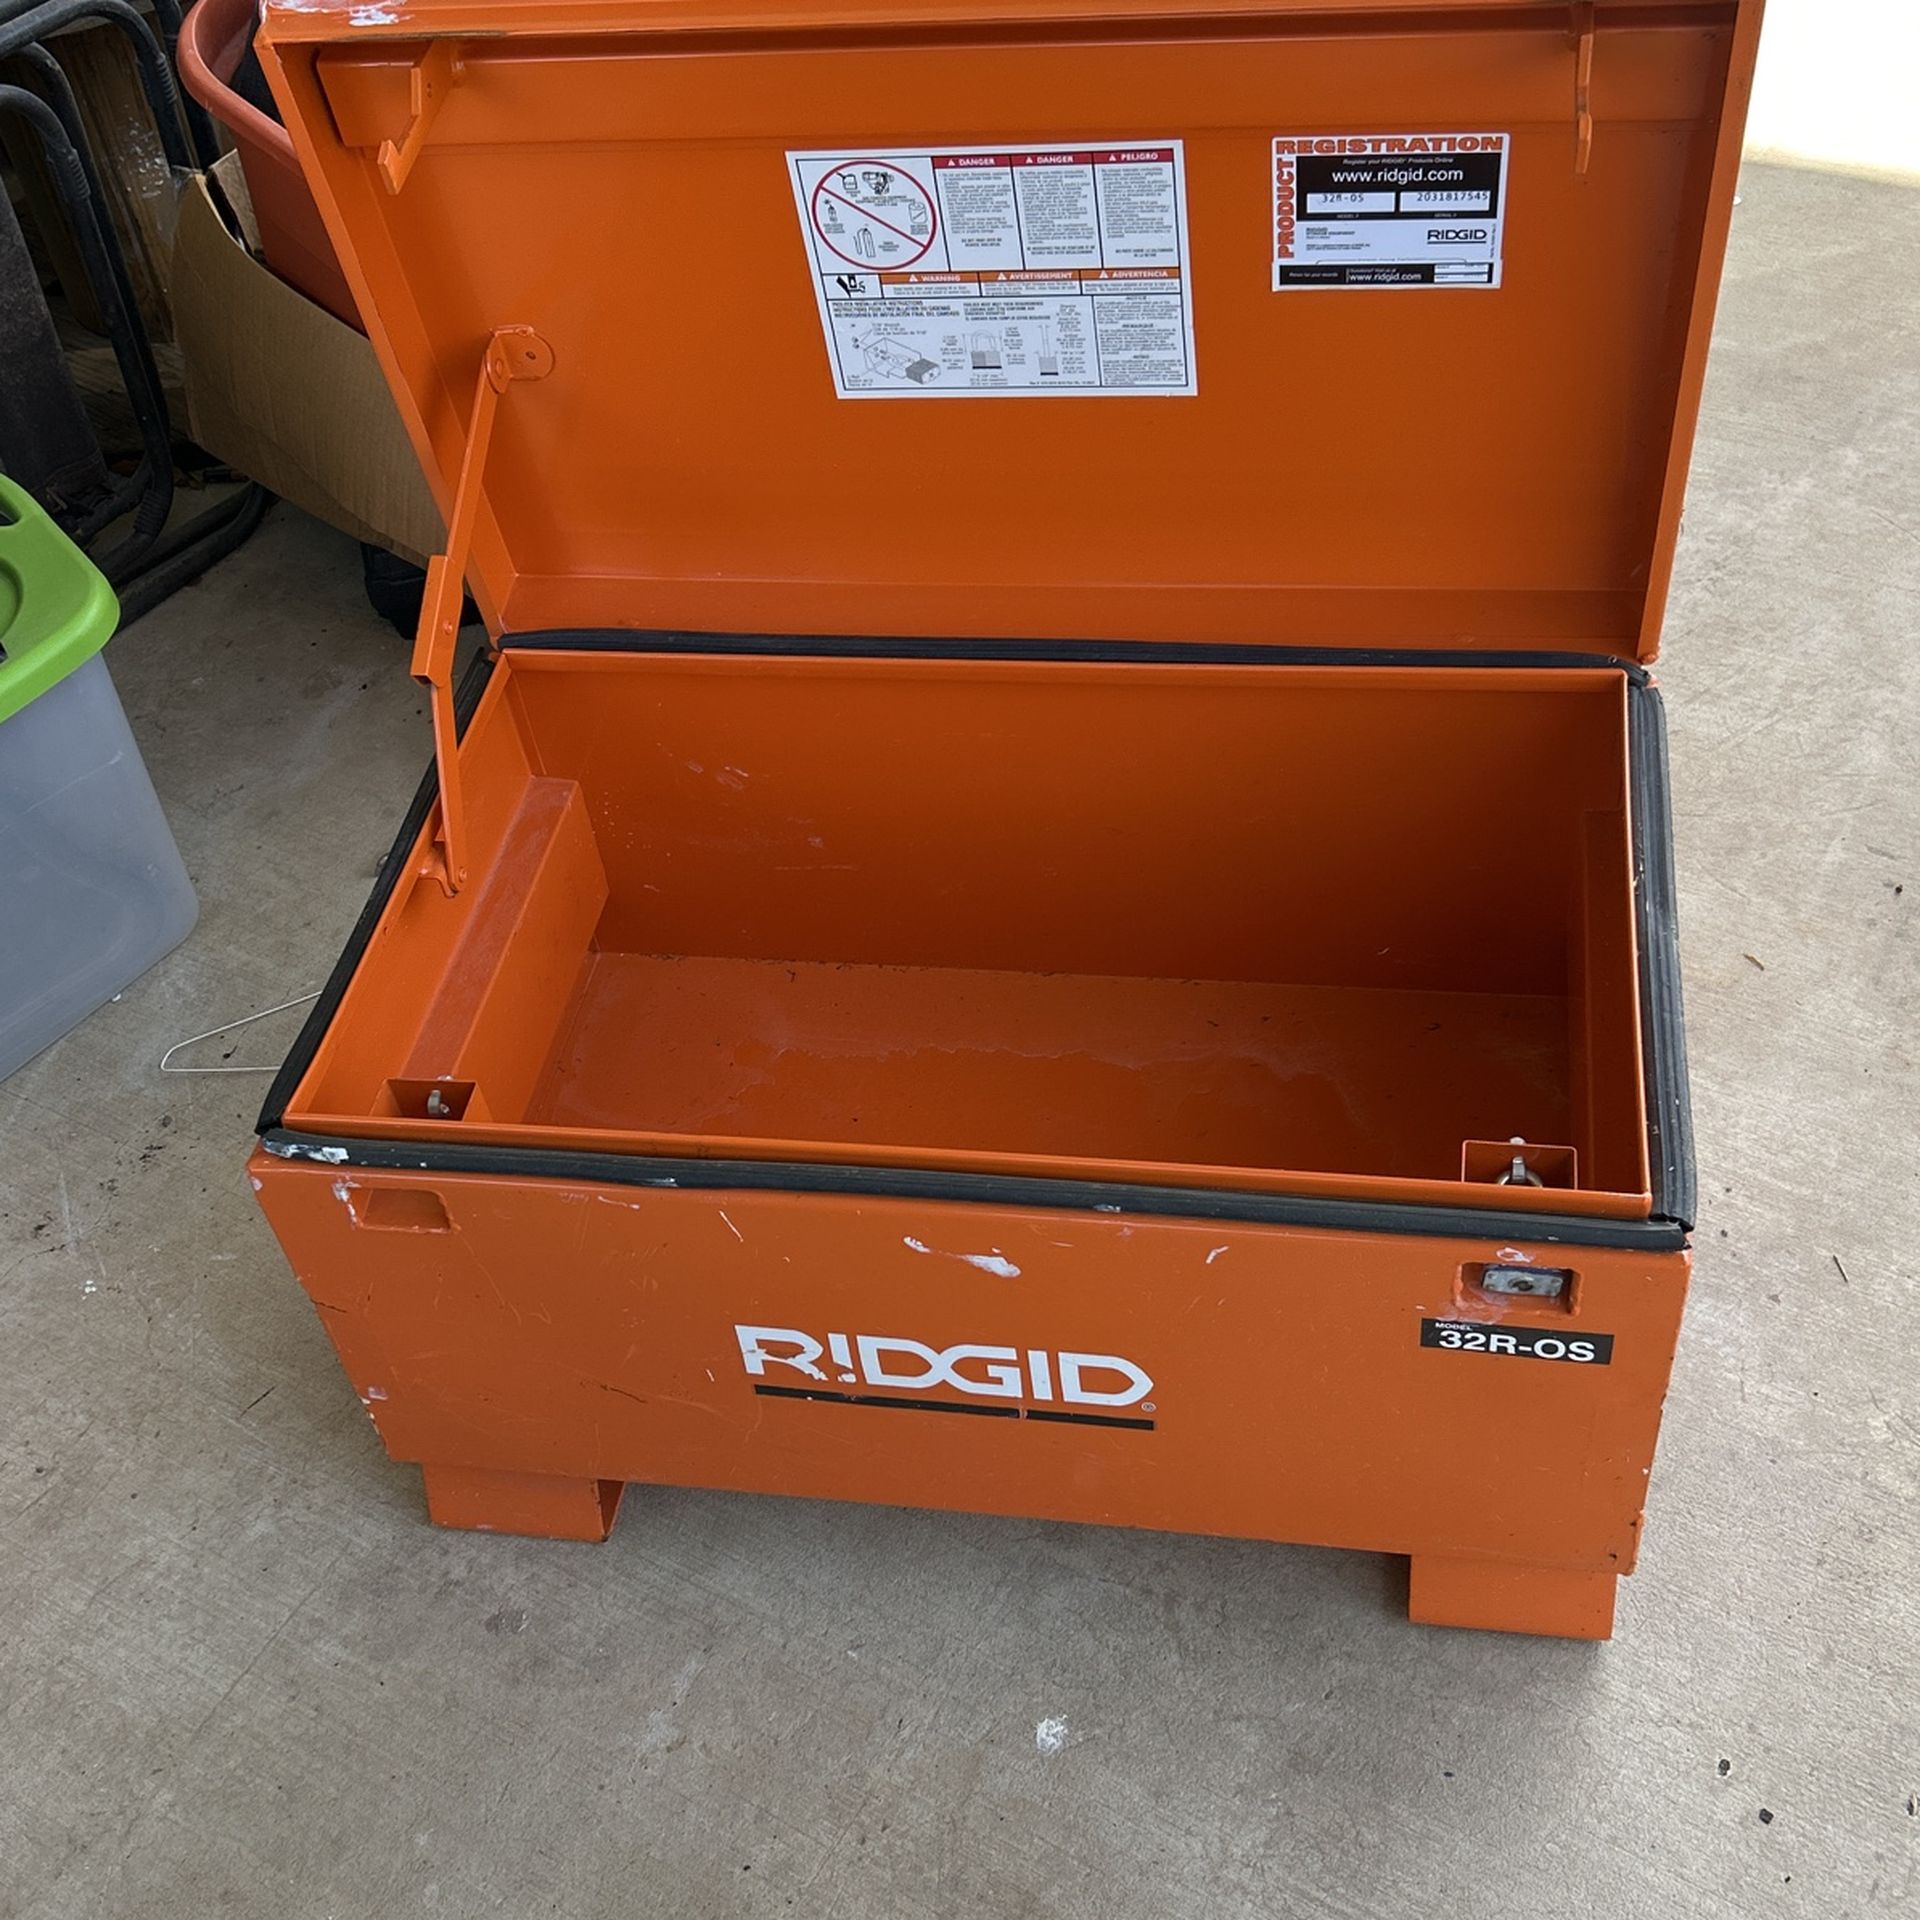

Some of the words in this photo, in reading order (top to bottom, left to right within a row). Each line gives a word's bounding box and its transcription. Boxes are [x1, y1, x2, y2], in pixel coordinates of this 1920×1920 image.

[1276, 136, 1504, 155] REGISTRATION
[959, 157, 996, 167] DANGER
[1037, 154, 1074, 165] DANGER
[1121, 152, 1159, 162] PELIGRO
[1332, 167, 1464, 185] www.ridgid.com
[1276, 157, 1295, 260] PRODUCT
[1427, 229, 1487, 241] RIDGID
[921, 274, 960, 283] WARNING
[1009, 271, 1073, 281] AVERTISSEMENT
[1112, 269, 1168, 279] ADVERTENCIA
[1350, 272, 1422, 282] www.ridgid.com
[1435, 1321, 1473, 1331] MODEL
[1438, 1330, 1595, 1362] 32R-OS
[734, 1324, 1155, 1406] RIDGID
